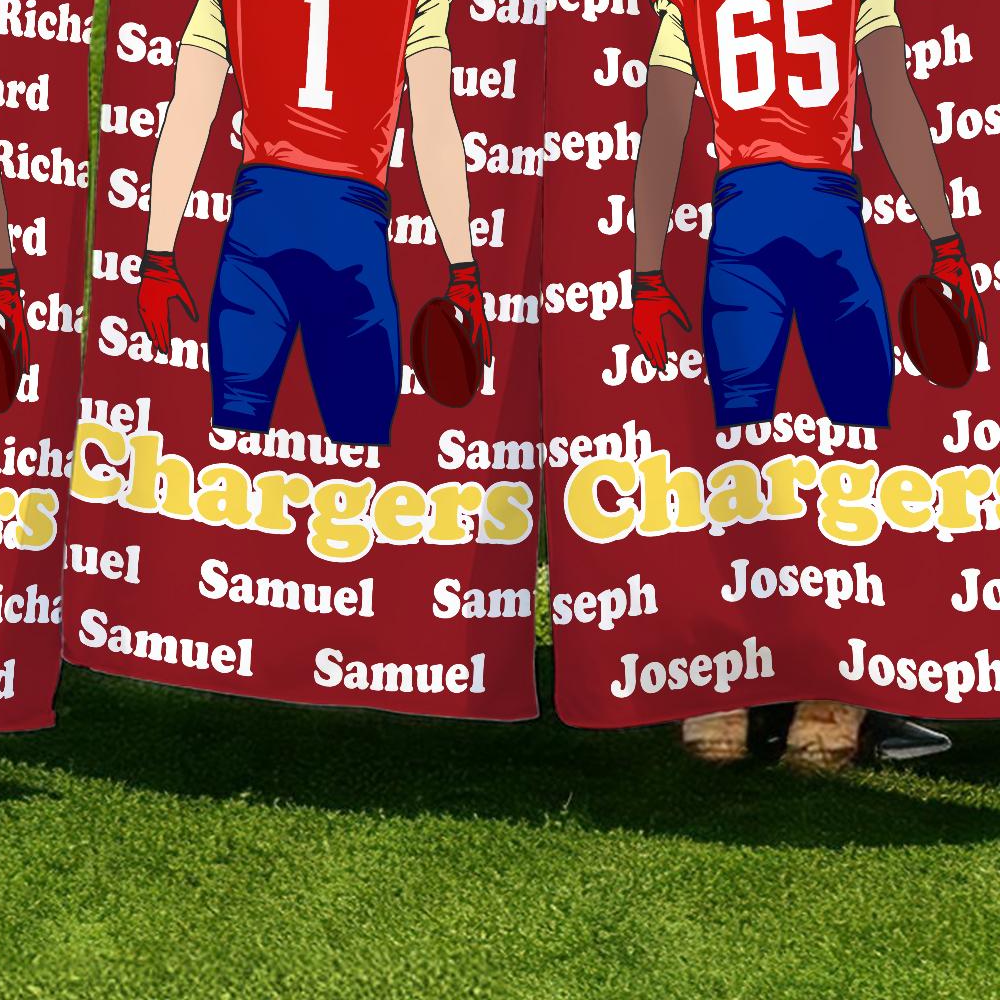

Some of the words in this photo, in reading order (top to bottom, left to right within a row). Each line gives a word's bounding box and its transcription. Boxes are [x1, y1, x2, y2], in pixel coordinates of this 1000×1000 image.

[602, 344, 710, 386] Jose
[209, 420, 380, 469] Samuel
[438, 430, 542, 471] Sam
[539, 420, 651, 467] seph
[716, 412, 878, 455] Joseph
[70, 421, 533, 562] Chargers
[564, 449, 1000, 546] Charger
[64, 544, 141, 584] uel
[199, 559, 374, 617] Samuel
[553, 574, 658, 630] seph
[721, 559, 885, 609] Joseph
[79, 609, 253, 676] Samuel
[314, 648, 485, 693] Samuel
[611, 636, 774, 698] Joseph
[839, 638, 1000, 703] Joseph
